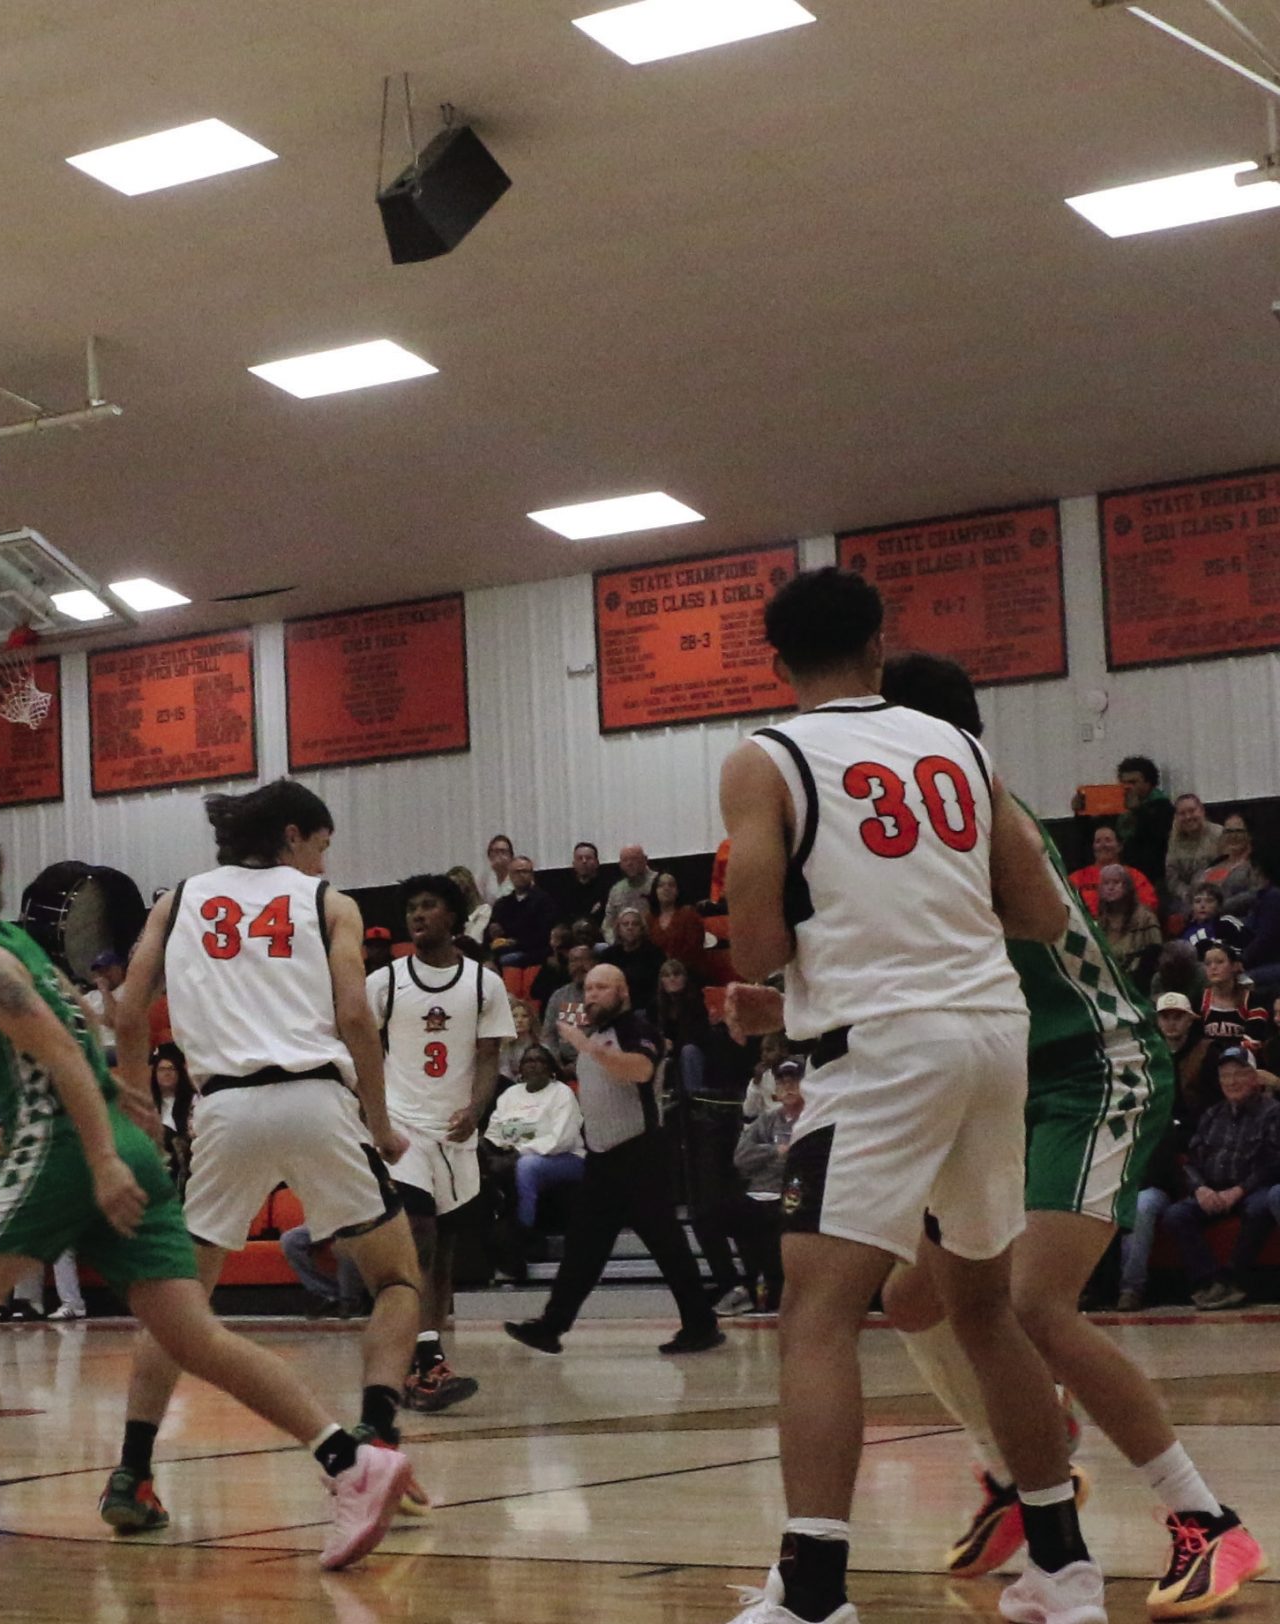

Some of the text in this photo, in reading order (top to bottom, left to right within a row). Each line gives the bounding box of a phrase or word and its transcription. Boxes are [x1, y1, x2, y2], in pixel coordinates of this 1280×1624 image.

[629, 559, 757, 595] STATE CHAMPIONS
[662, 591, 706, 613] CLASS
[710, 589, 719, 607] A
[723, 582, 766, 605] GIRLS
[842, 754, 978, 859] 30
[200, 895, 295, 961] 34
[423, 1040, 449, 1078] 3
